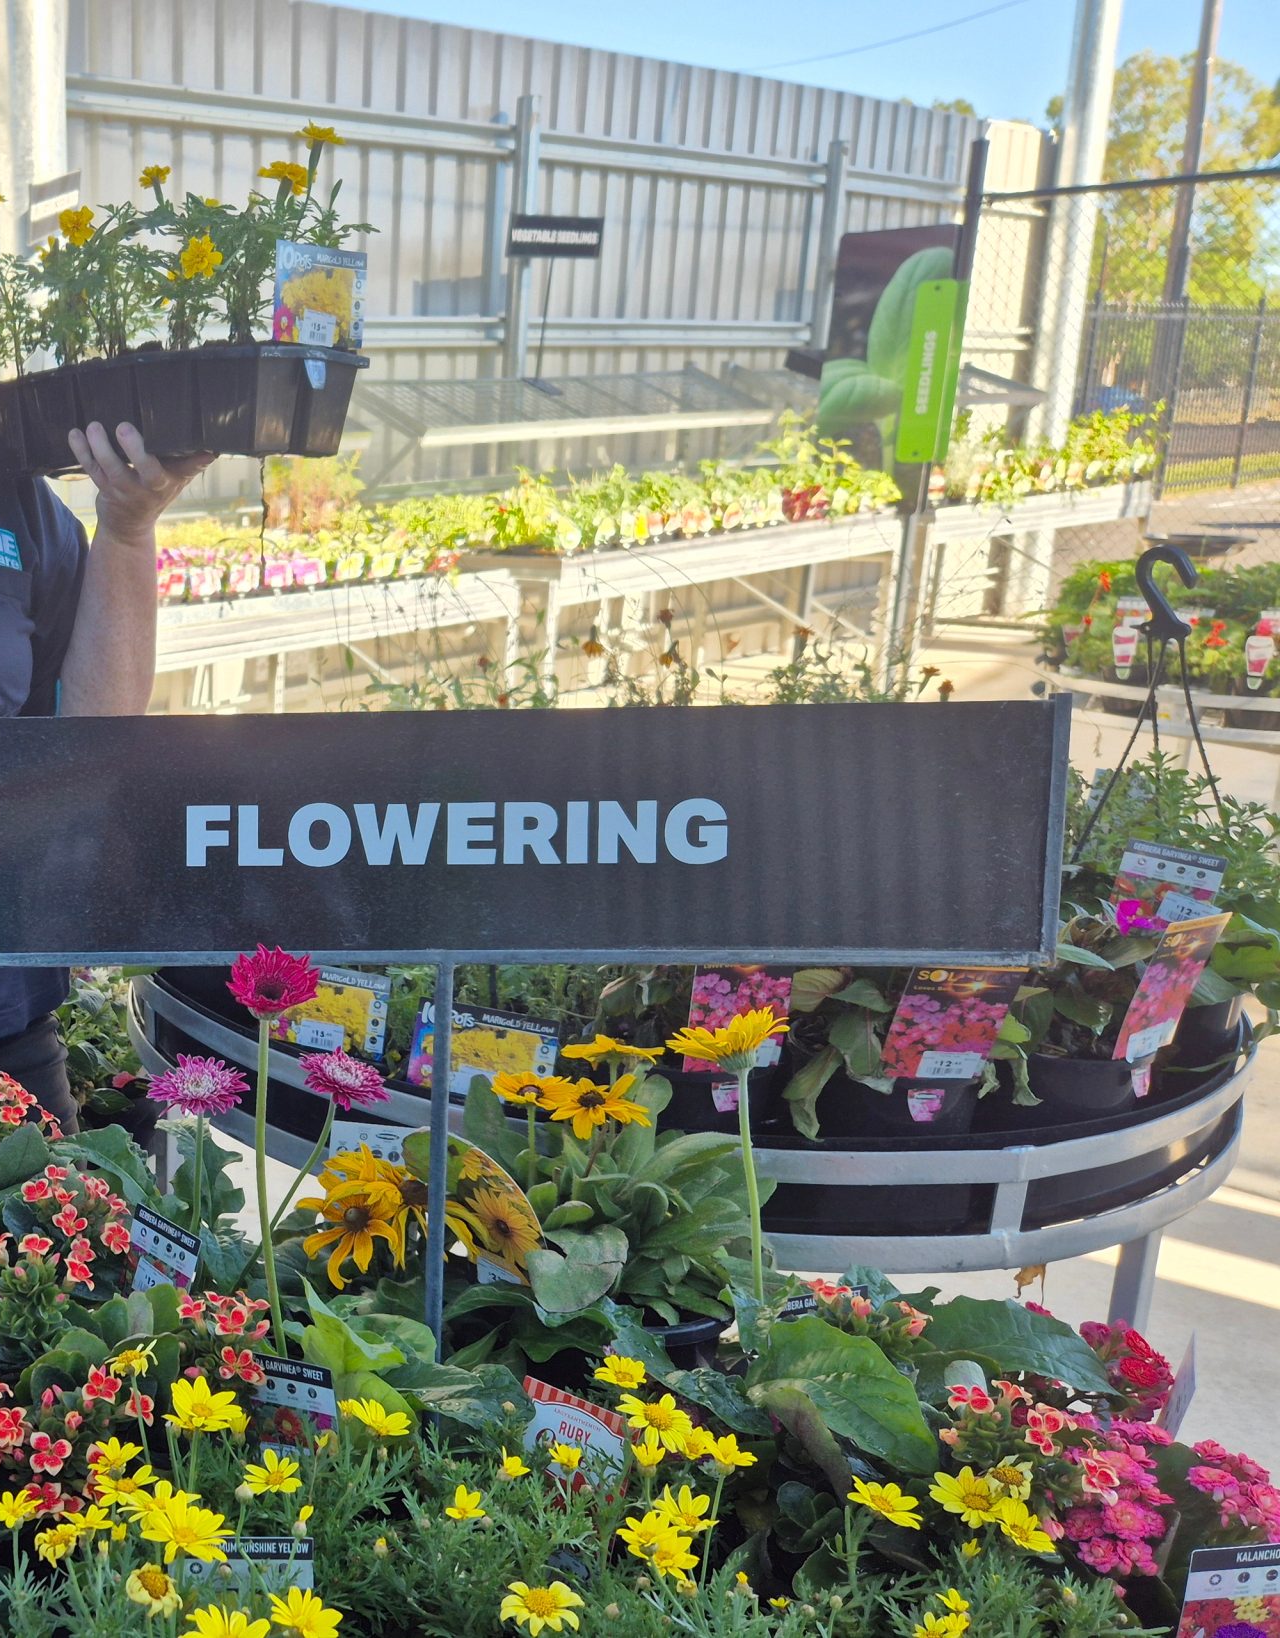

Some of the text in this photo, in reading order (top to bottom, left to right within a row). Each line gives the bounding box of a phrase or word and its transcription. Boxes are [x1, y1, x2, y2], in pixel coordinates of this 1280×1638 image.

[914, 330, 939, 416] SEEDLINGS
[185, 797, 729, 868] FLOWERING
[481, 1013, 520, 1029] MARIGOLD
[302, 1368, 324, 1381] SWEET
[558, 1420, 592, 1446] RUBY
